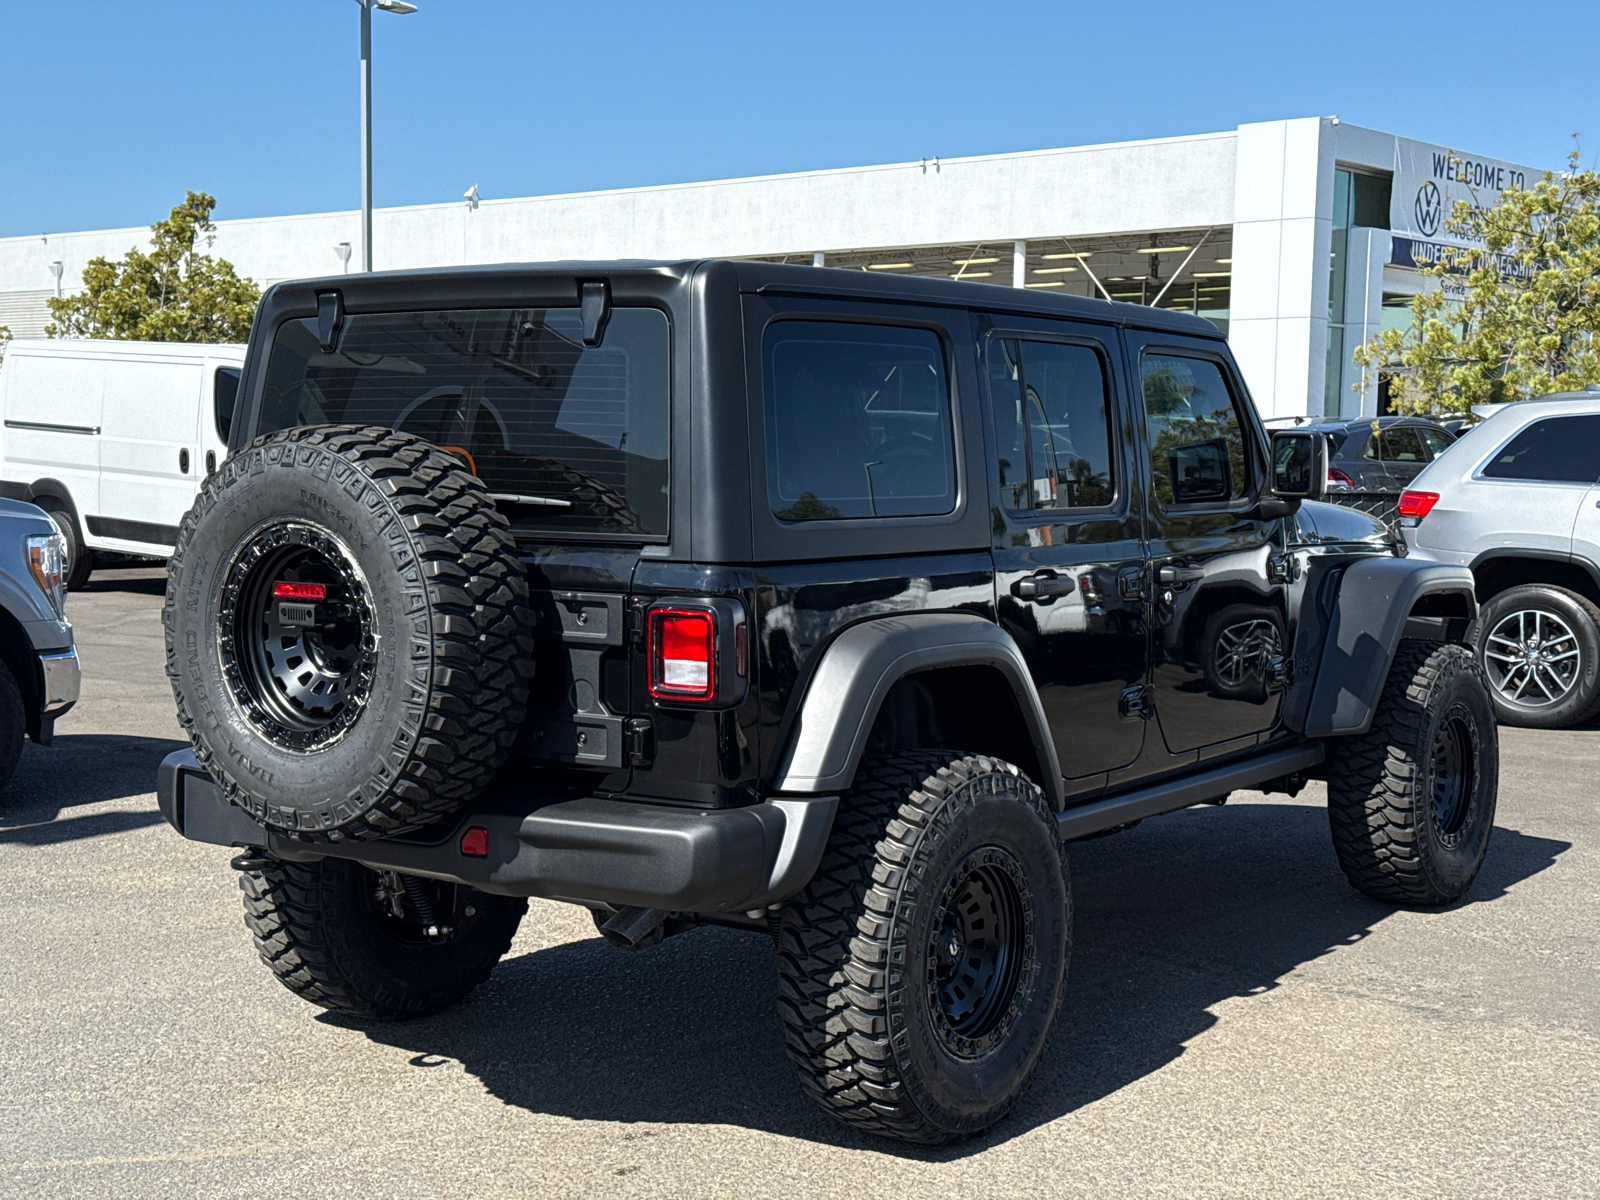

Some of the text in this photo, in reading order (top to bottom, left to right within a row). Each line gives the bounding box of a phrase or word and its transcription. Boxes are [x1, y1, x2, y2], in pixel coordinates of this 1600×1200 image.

[1433, 152, 1525, 192] WELCOME TO
[300, 488, 370, 551] MICKEY
[184, 630, 221, 735] LEGEND
[227, 740, 276, 784] BAJA
